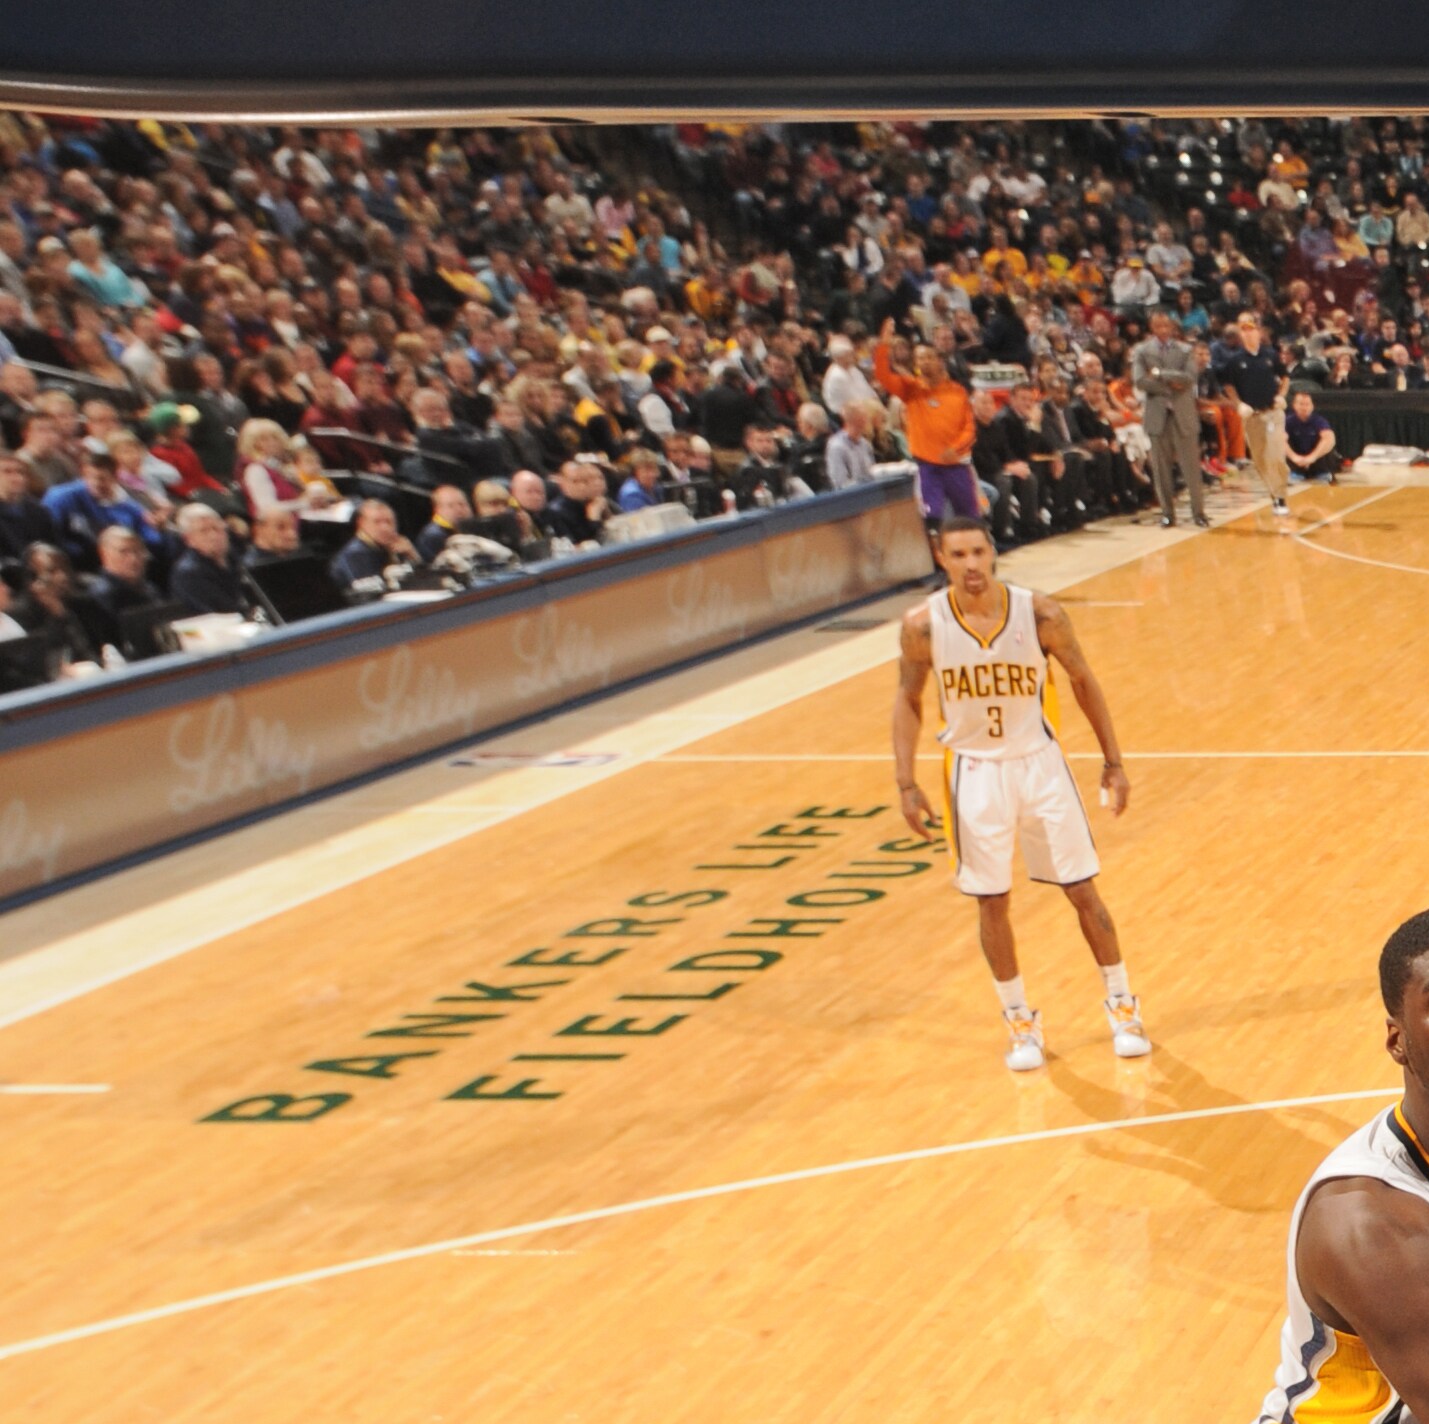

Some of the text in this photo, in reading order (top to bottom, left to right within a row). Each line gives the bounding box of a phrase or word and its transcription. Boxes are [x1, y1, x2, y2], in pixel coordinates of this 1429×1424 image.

[942, 662, 1038, 701] PACERS
[987, 705, 1004, 738] 3
[195, 804, 891, 1124] BANKERS LIFE
